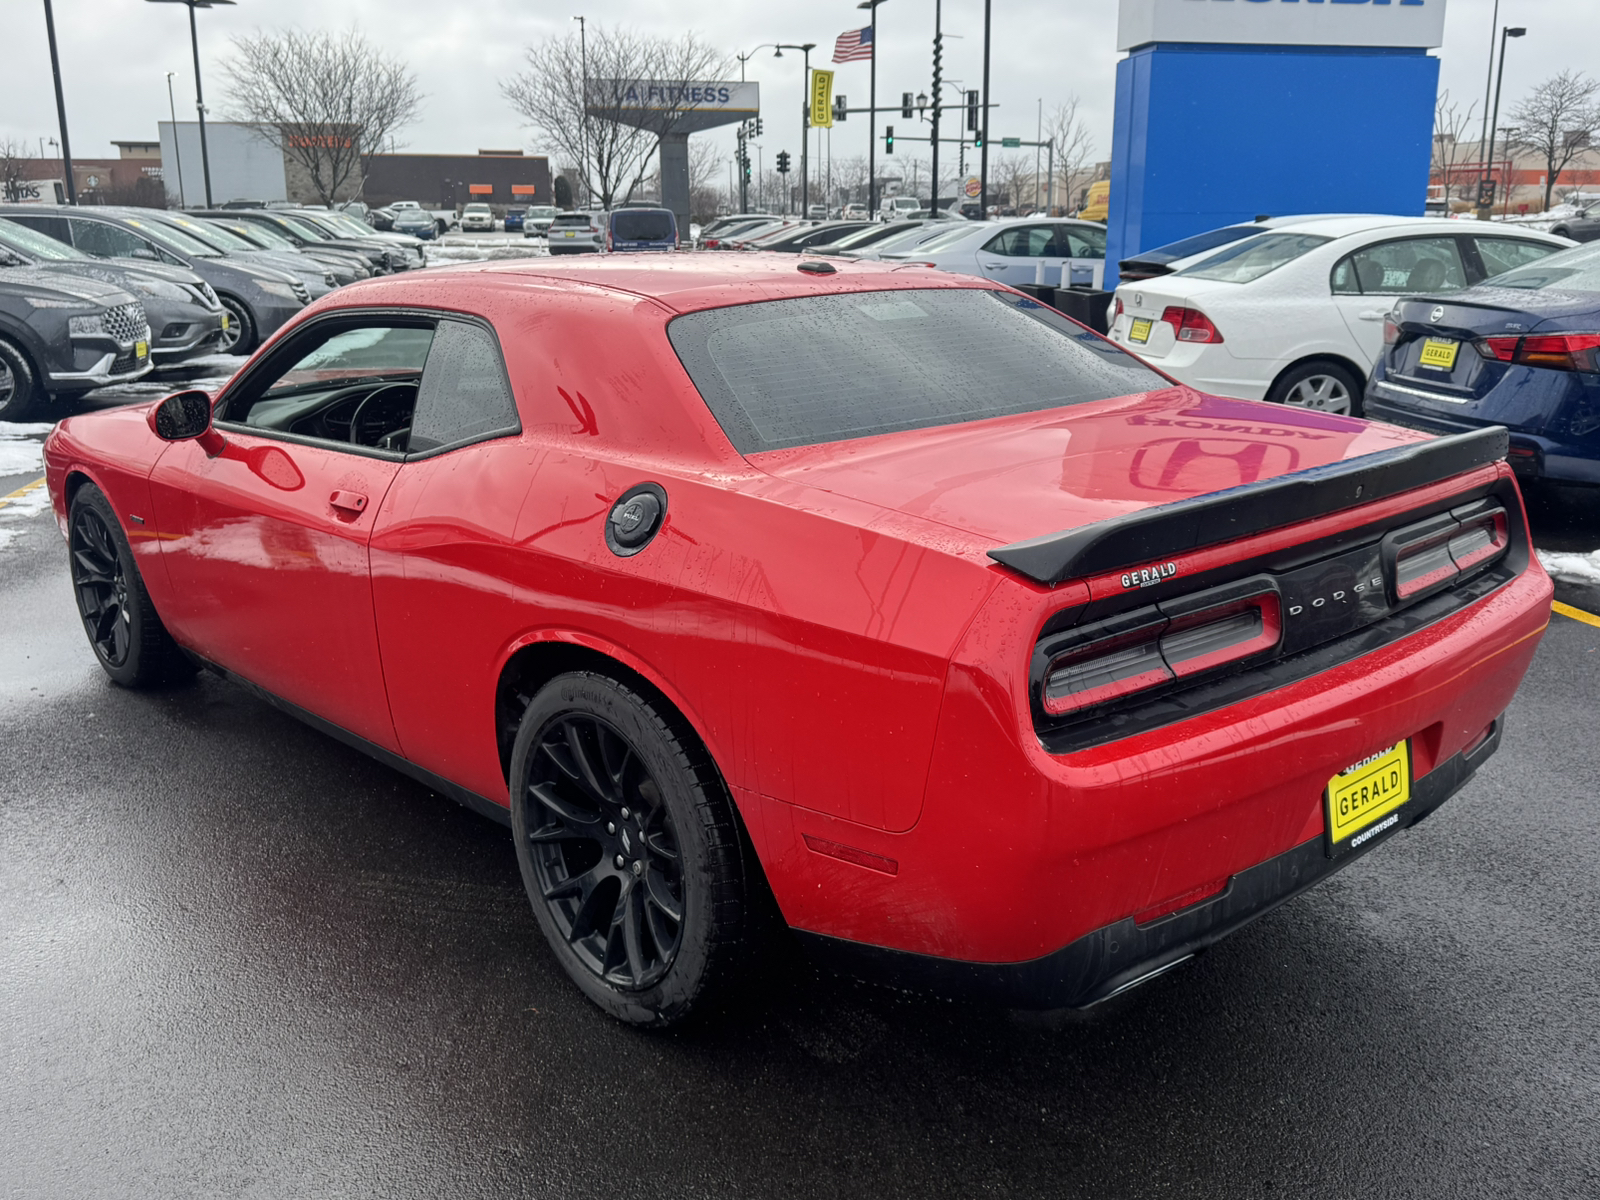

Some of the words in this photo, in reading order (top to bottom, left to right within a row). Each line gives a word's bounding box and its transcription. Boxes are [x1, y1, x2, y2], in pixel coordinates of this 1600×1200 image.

[648, 86, 731, 103] FITNESS
[817, 76, 826, 120] GERALD
[1425, 348, 1452, 359] GERALD
[1121, 562, 1177, 587] GERALD
[1289, 577, 1382, 616] DODGE
[1340, 770, 1399, 816] GERALD
[1351, 813, 1399, 848] COUNTRYSIDE
